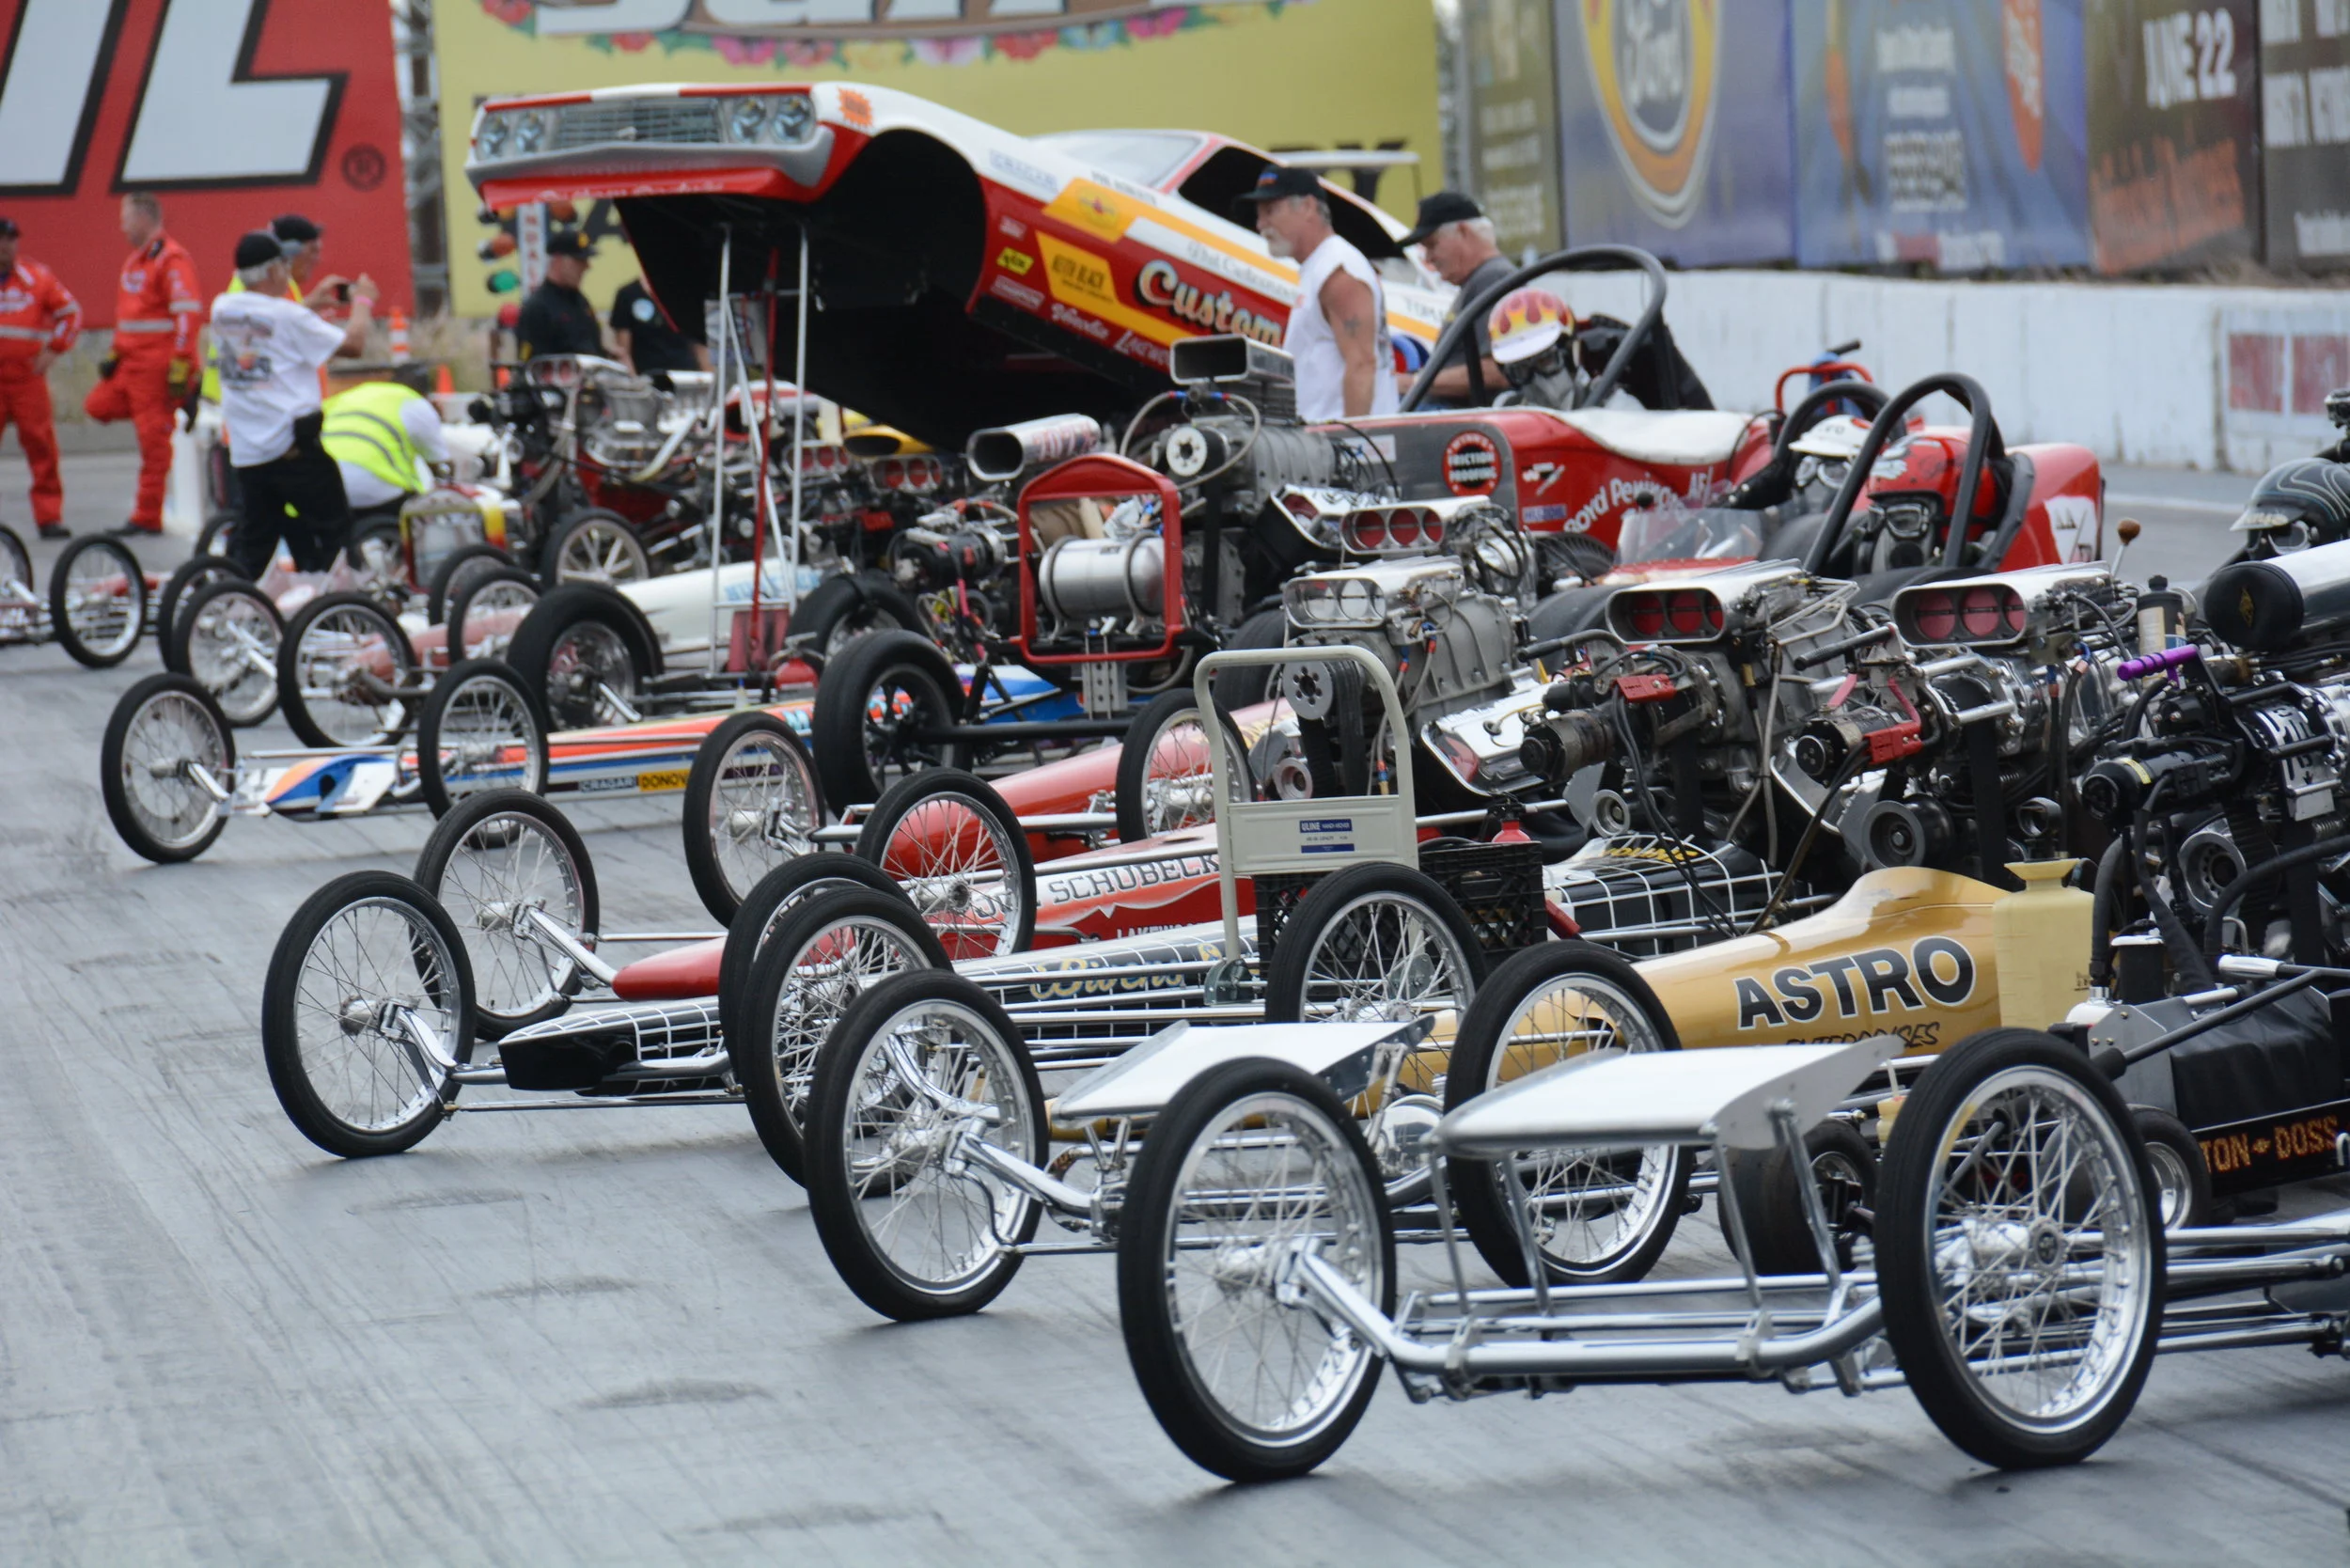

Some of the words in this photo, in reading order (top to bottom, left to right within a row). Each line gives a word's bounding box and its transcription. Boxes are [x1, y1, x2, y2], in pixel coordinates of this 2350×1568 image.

[2195, 8, 2237, 98] 22
[1136, 259, 1283, 349] Custom
[1448, 452, 1496, 466] FRICTION
[581, 777, 635, 792] CRAGAR
[1048, 853, 1220, 905] SCHUBECK
[1732, 935, 1976, 1031] ASTRO
[2272, 1116, 2338, 1160] DOSS
